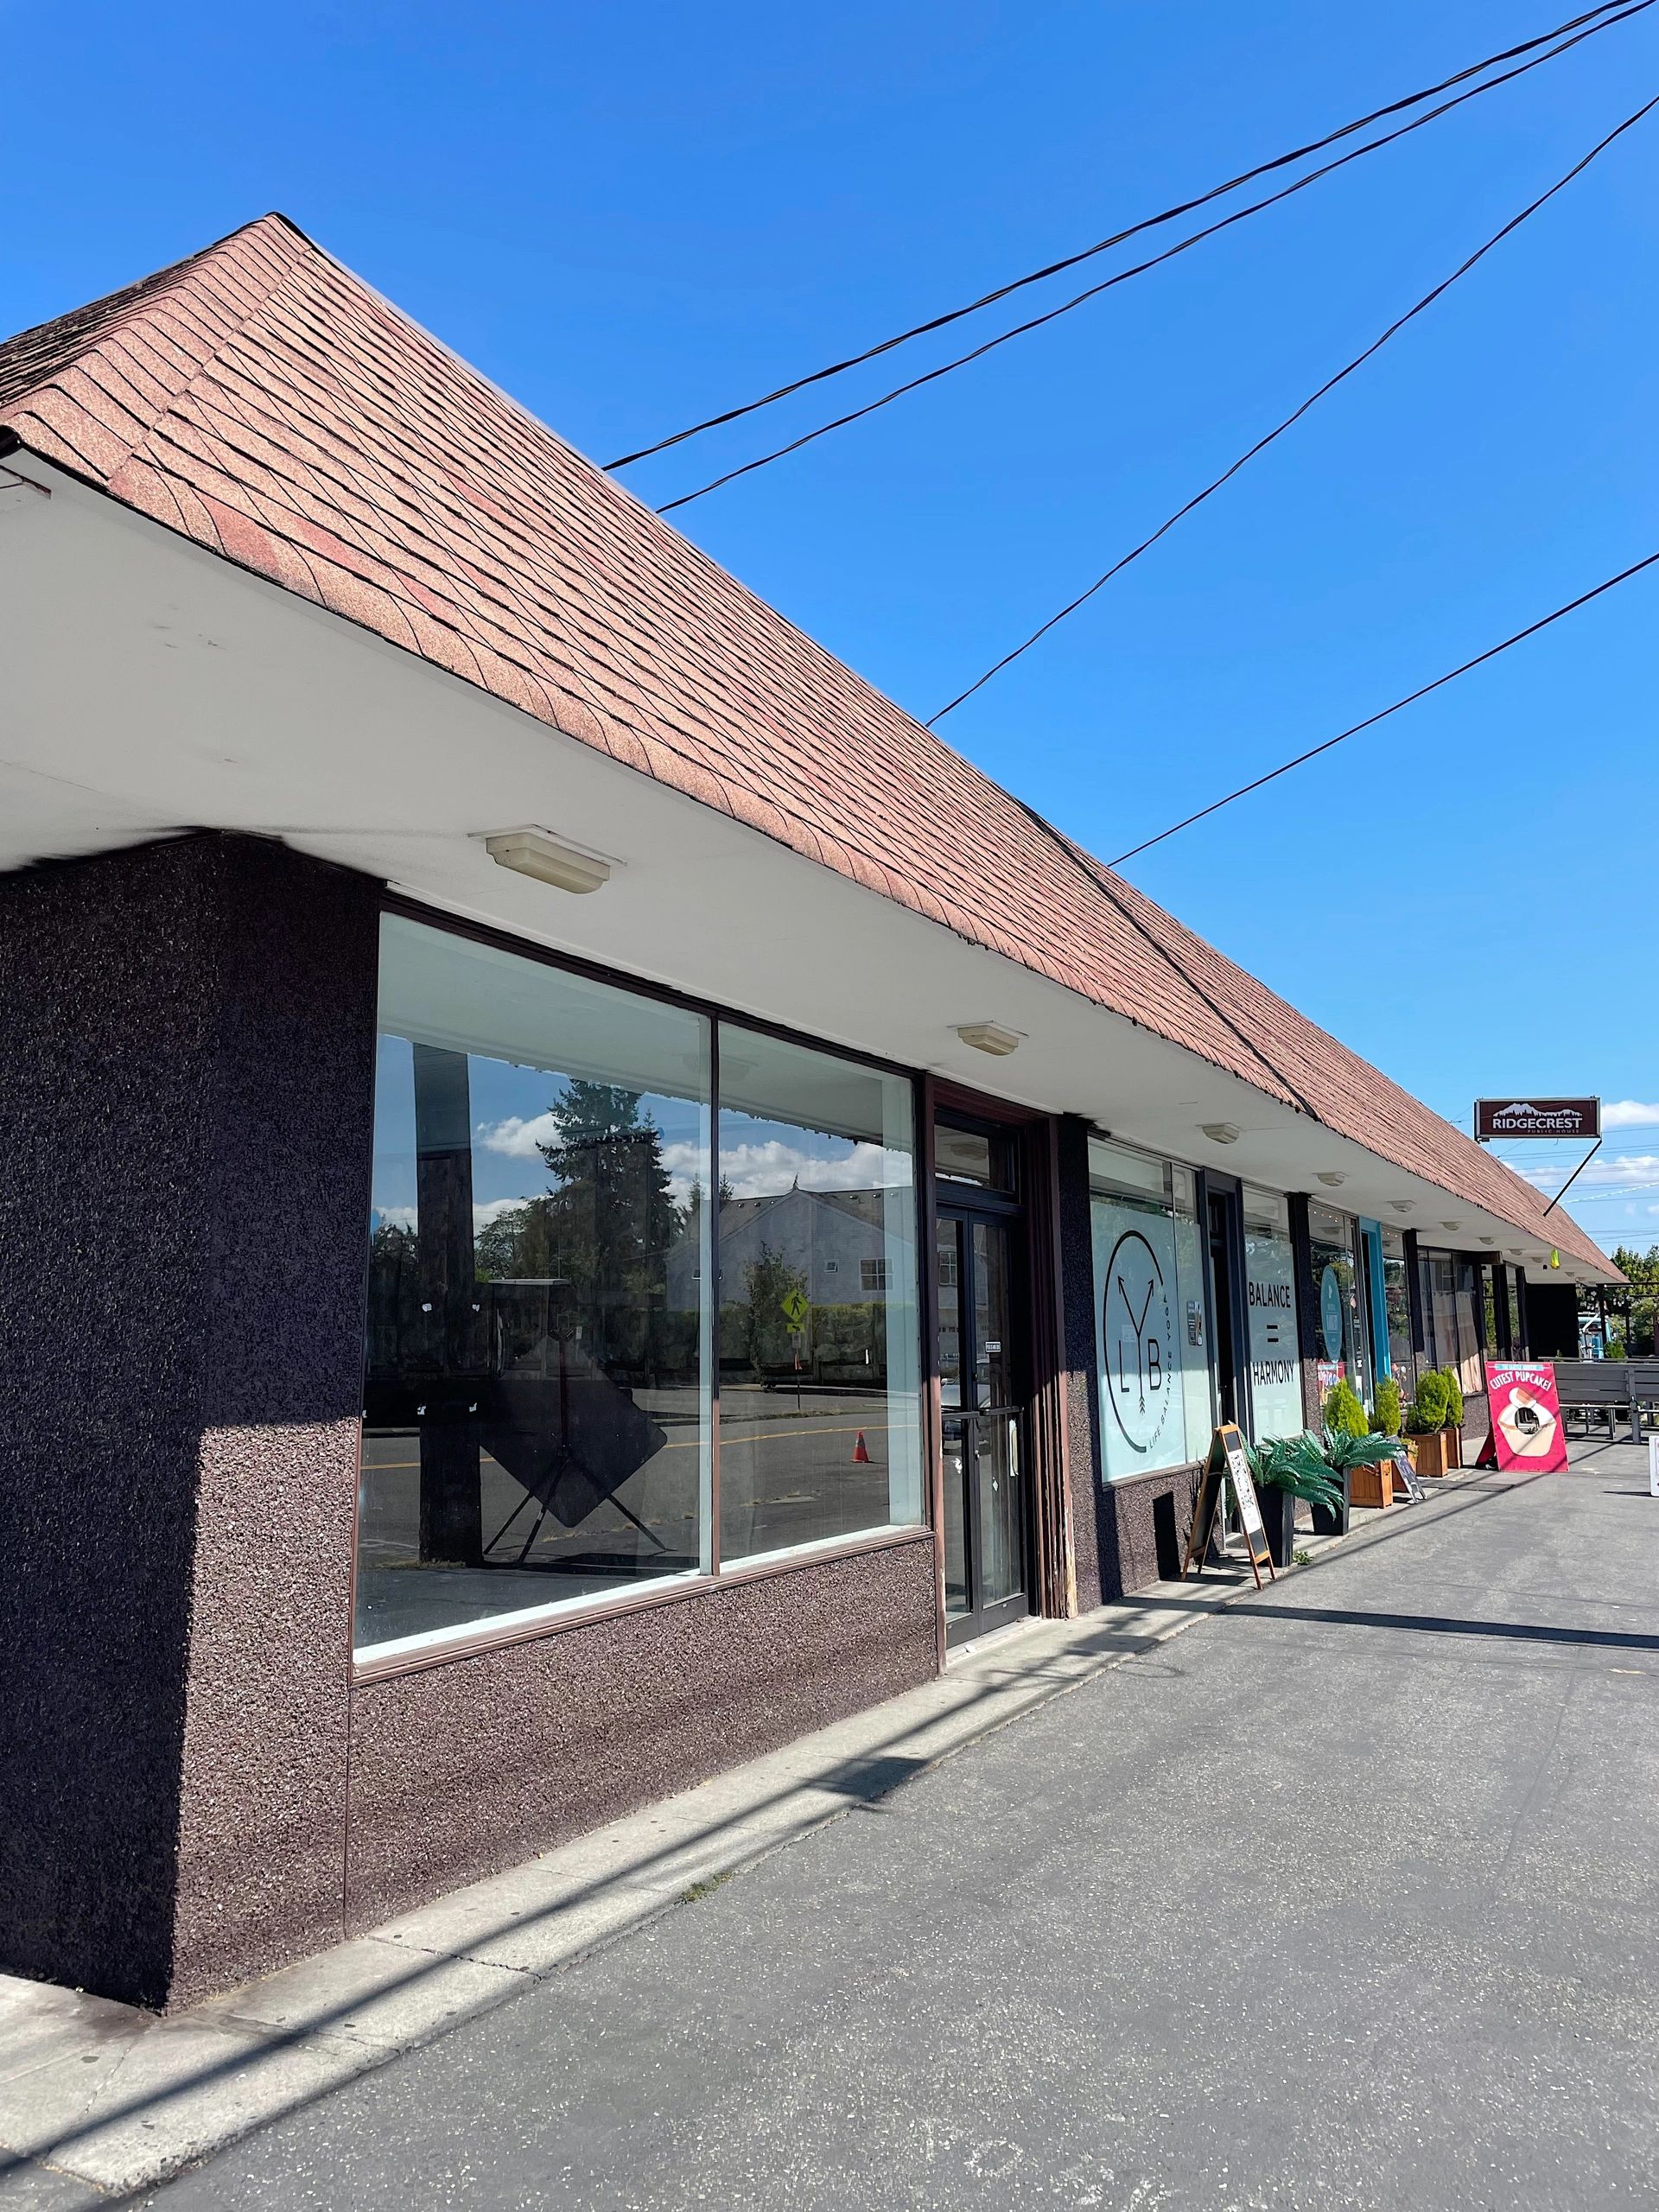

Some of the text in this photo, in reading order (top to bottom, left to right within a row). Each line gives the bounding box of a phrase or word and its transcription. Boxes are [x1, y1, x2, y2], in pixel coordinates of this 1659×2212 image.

[1493, 1118, 1583, 1129] RIDGECREST
[1249, 1281, 1291, 1308] BALANCE
[1252, 1359, 1294, 1387] HARMONY
[1490, 1371, 1552, 1392] CUTEST PUPCAKE!
[1149, 1426, 1161, 1449] LIFE
[1160, 1351, 1173, 1426] BALANCE
